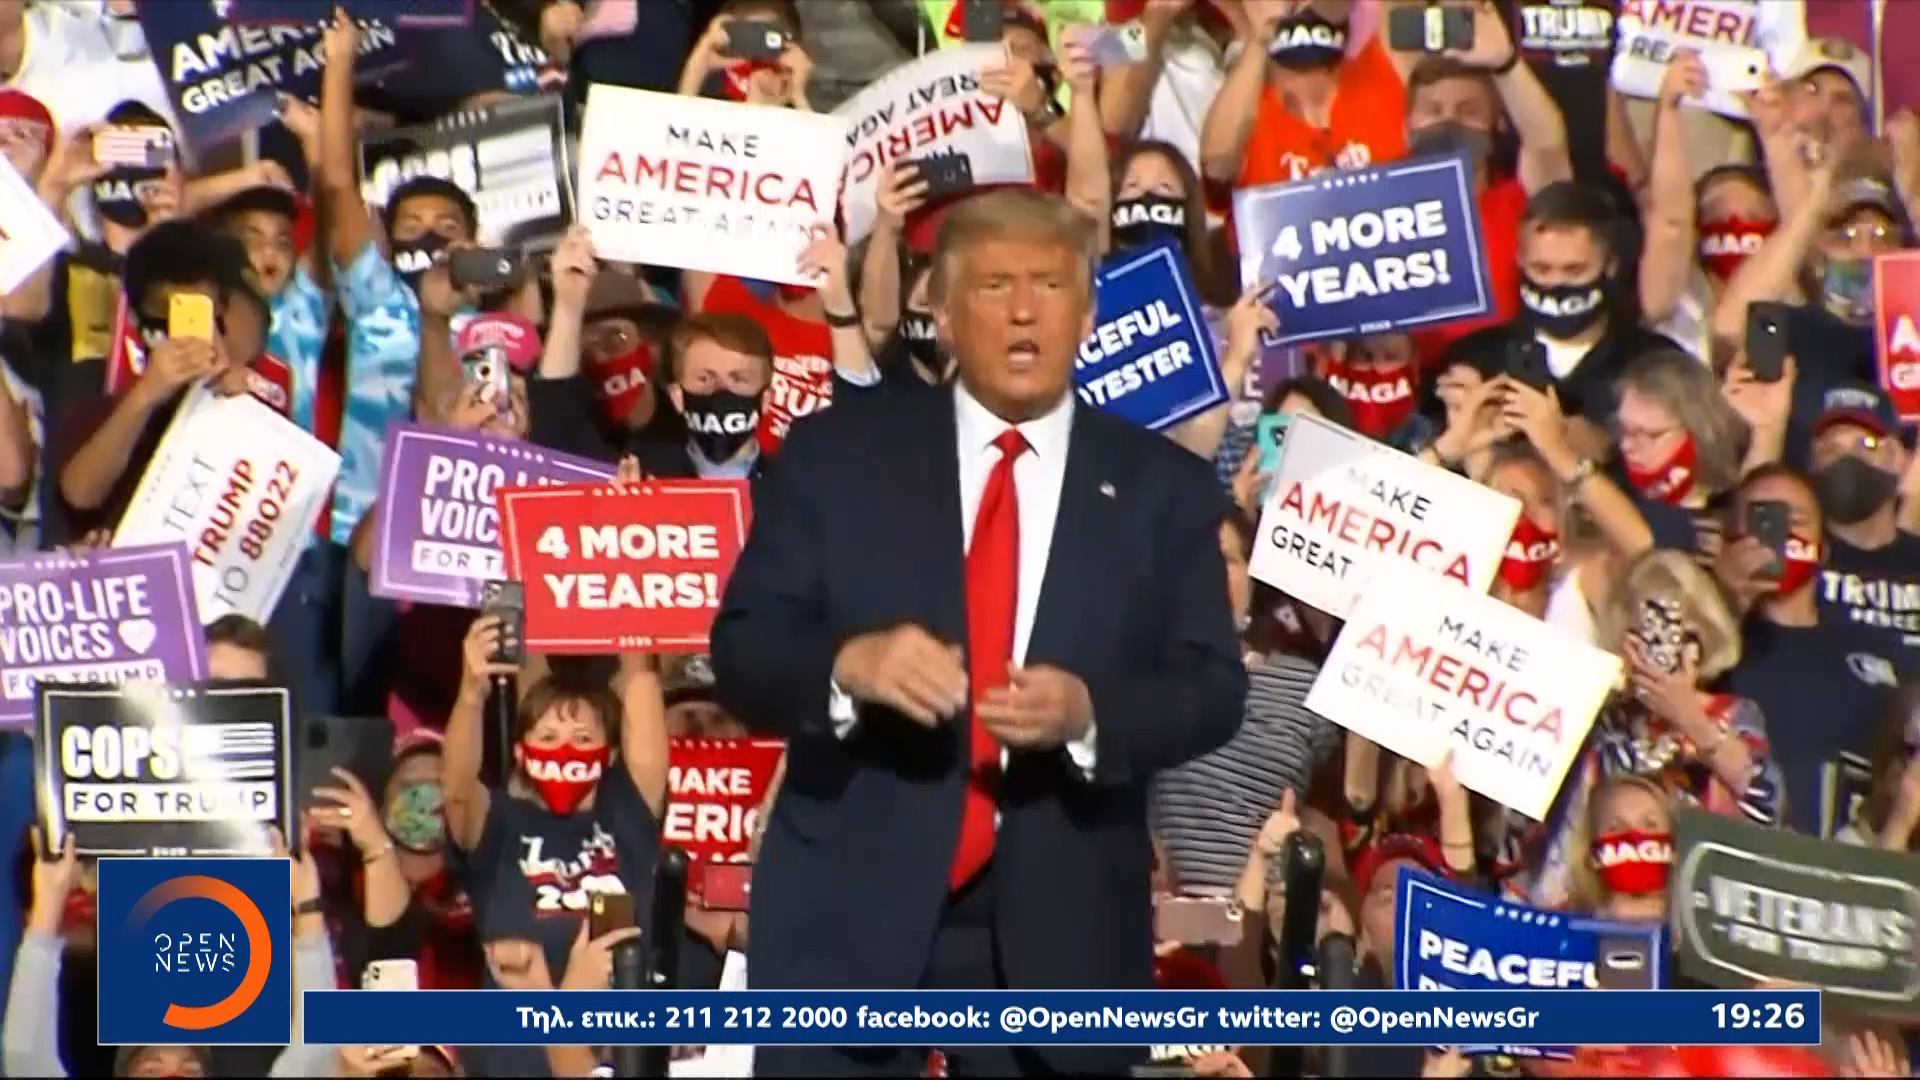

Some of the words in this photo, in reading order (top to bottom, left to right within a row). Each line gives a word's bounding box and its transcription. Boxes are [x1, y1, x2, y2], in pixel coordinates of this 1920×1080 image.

[1622, 0, 1758, 46] AMERI
[181, 56, 284, 114] GREAT
[905, 72, 979, 115] REAT
[666, 123, 760, 159] MAKE
[596, 150, 818, 212] AMERICA
[593, 195, 700, 225] GREAT
[1272, 225, 1302, 260] 4
[1310, 199, 1447, 256] MORE
[1278, 249, 1451, 308] YEARS!
[1076, 300, 1182, 370] CEFUL
[603, 367, 646, 396] GA
[1078, 340, 1193, 406] TESTER
[191, 458, 253, 566] TRUMP
[213, 565, 249, 608] TO
[239, 459, 299, 560] 88022
[1279, 481, 1470, 588] AMERICA
[419, 547, 471, 568] FOR
[536, 525, 570, 559] 4
[579, 525, 720, 559] MORE
[1271, 524, 1354, 581] GREAT
[542, 573, 720, 609] YEARS!
[0, 621, 115, 664] VOICES
[1438, 615, 1531, 673] MAKE
[1355, 623, 1565, 744] AMERICA
[1340, 661, 1445, 724] GREAT
[1448, 718, 1552, 779] AGAIN
[61, 724, 181, 780] COPS
[72, 791, 139, 814] FOR
